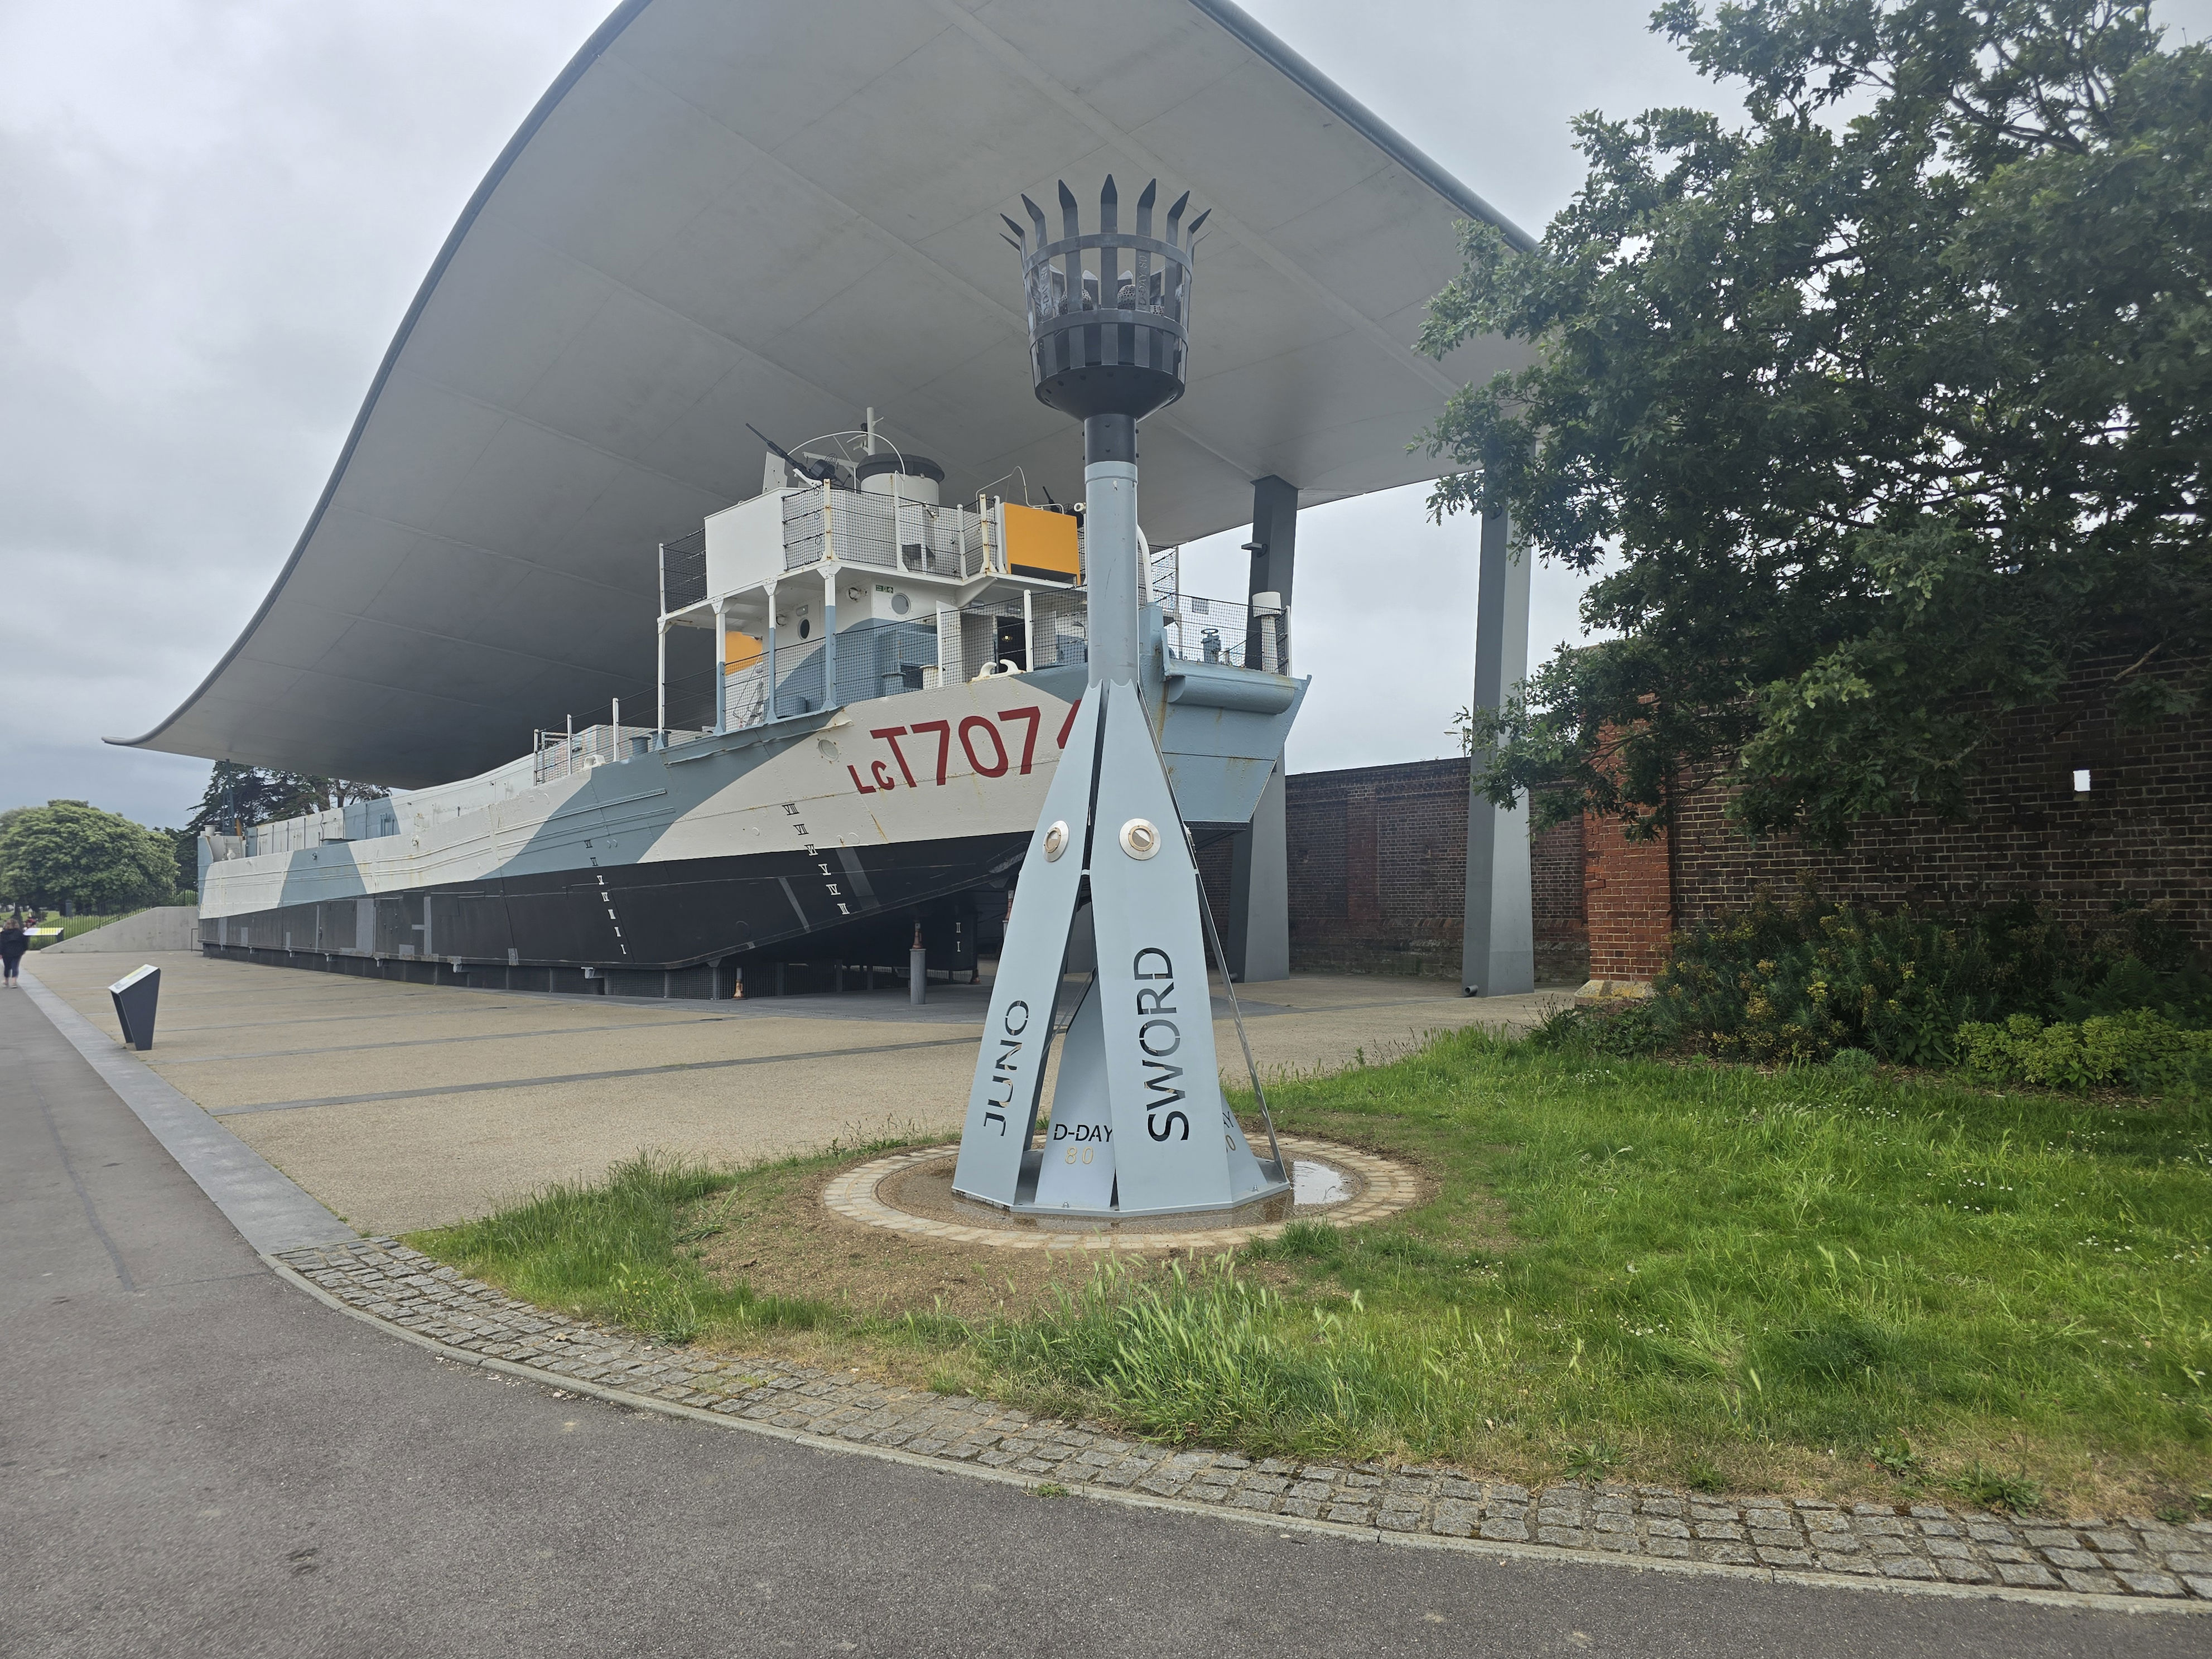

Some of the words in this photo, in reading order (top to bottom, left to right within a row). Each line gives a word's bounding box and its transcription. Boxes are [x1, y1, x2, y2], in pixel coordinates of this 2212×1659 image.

[782, 803, 799, 816] VIII
[793, 823, 809, 835] VII
[818, 863, 832, 876] V
[826, 884, 841, 895] IV
[837, 903, 850, 915] III
[956, 922, 961, 933] II
[1133, 947, 1189, 1142] SWORD
[984, 1000, 1029, 1137] JUNO
[1053, 1123, 1112, 1142] D-DAY
[1064, 1146, 1094, 1165] 80
